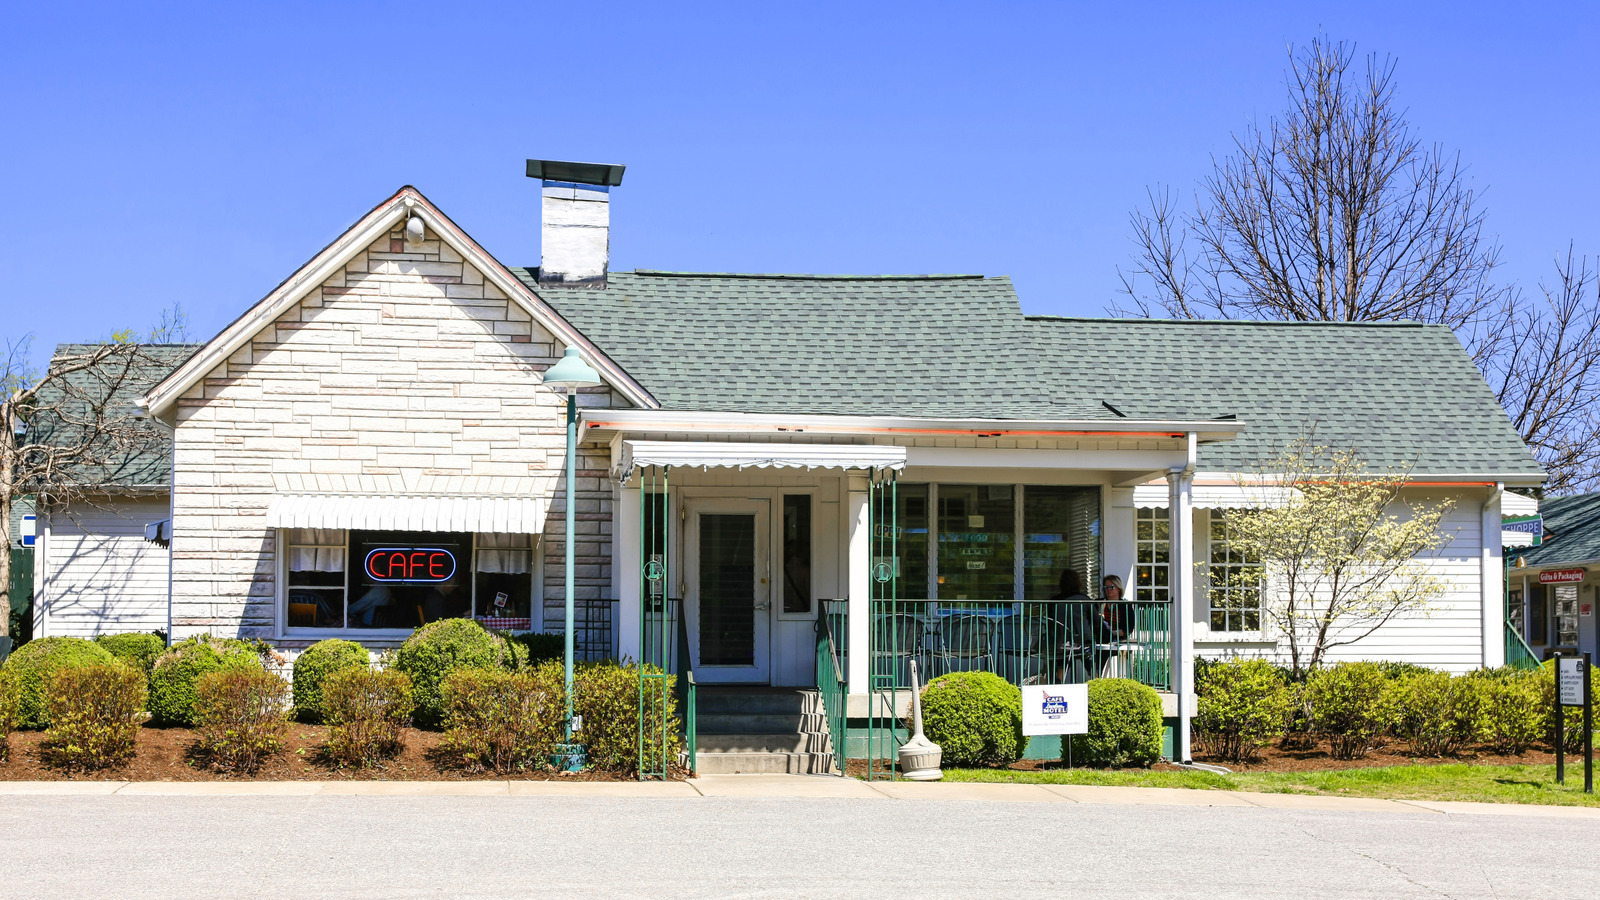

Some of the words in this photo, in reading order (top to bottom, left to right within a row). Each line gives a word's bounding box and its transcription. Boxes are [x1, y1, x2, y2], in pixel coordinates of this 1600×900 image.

[876, 525, 900, 538] OPEN
[369, 552, 445, 578] CAFE
[648, 562, 660, 579] L
[877, 565, 889, 581] L
[1540, 573, 1553, 581] Gifts
[1553, 572, 1558, 580] &
[1558, 571, 1583, 580] Packaging
